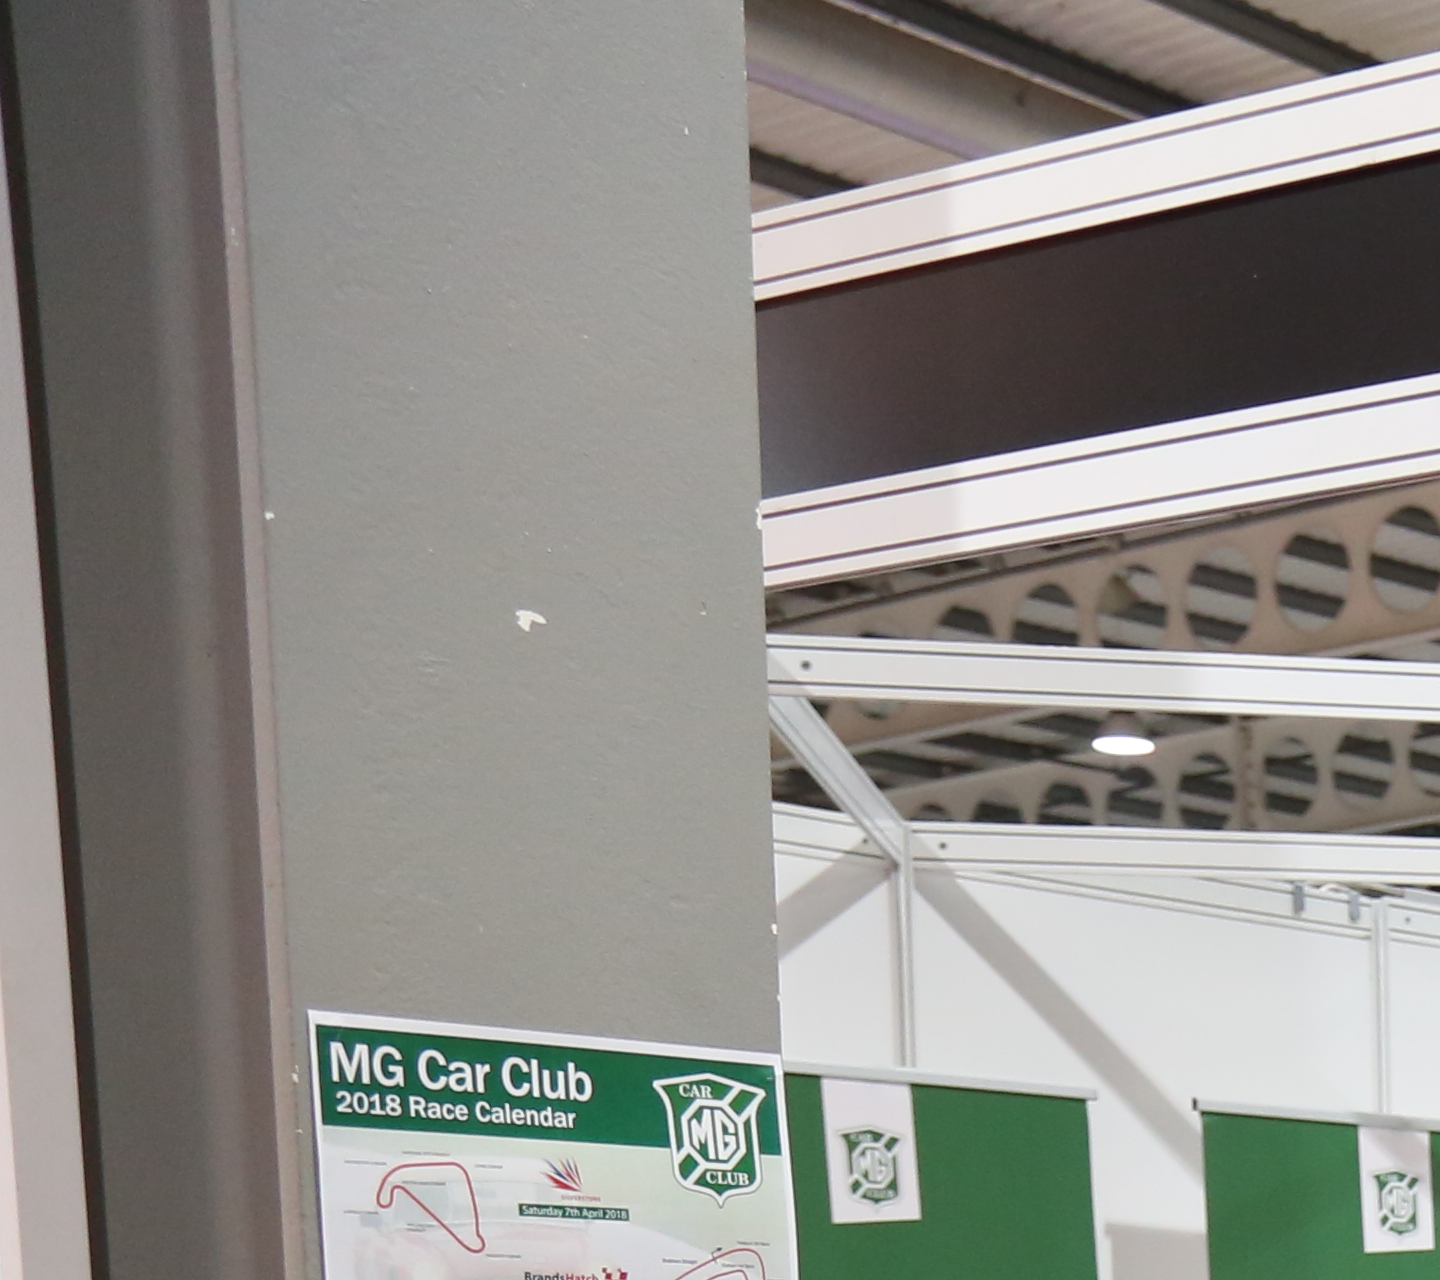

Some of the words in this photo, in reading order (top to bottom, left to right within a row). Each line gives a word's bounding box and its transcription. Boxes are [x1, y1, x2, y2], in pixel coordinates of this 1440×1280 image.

[330, 1041, 404, 1088] MG
[417, 1049, 490, 1094] Car
[501, 1056, 593, 1103] Club
[678, 1082, 713, 1101] CAR
[336, 1090, 402, 1117] 2018
[408, 1095, 468, 1122] Race
[474, 1101, 576, 1130] Calendar
[689, 1108, 737, 1160] MG
[705, 1169, 750, 1187] CLUB
[522, 1205, 562, 1219] Saturday
[564, 1206, 580, 1218] 7th
[582, 1208, 602, 1220] April
[605, 1208, 628, 1220] 2018
